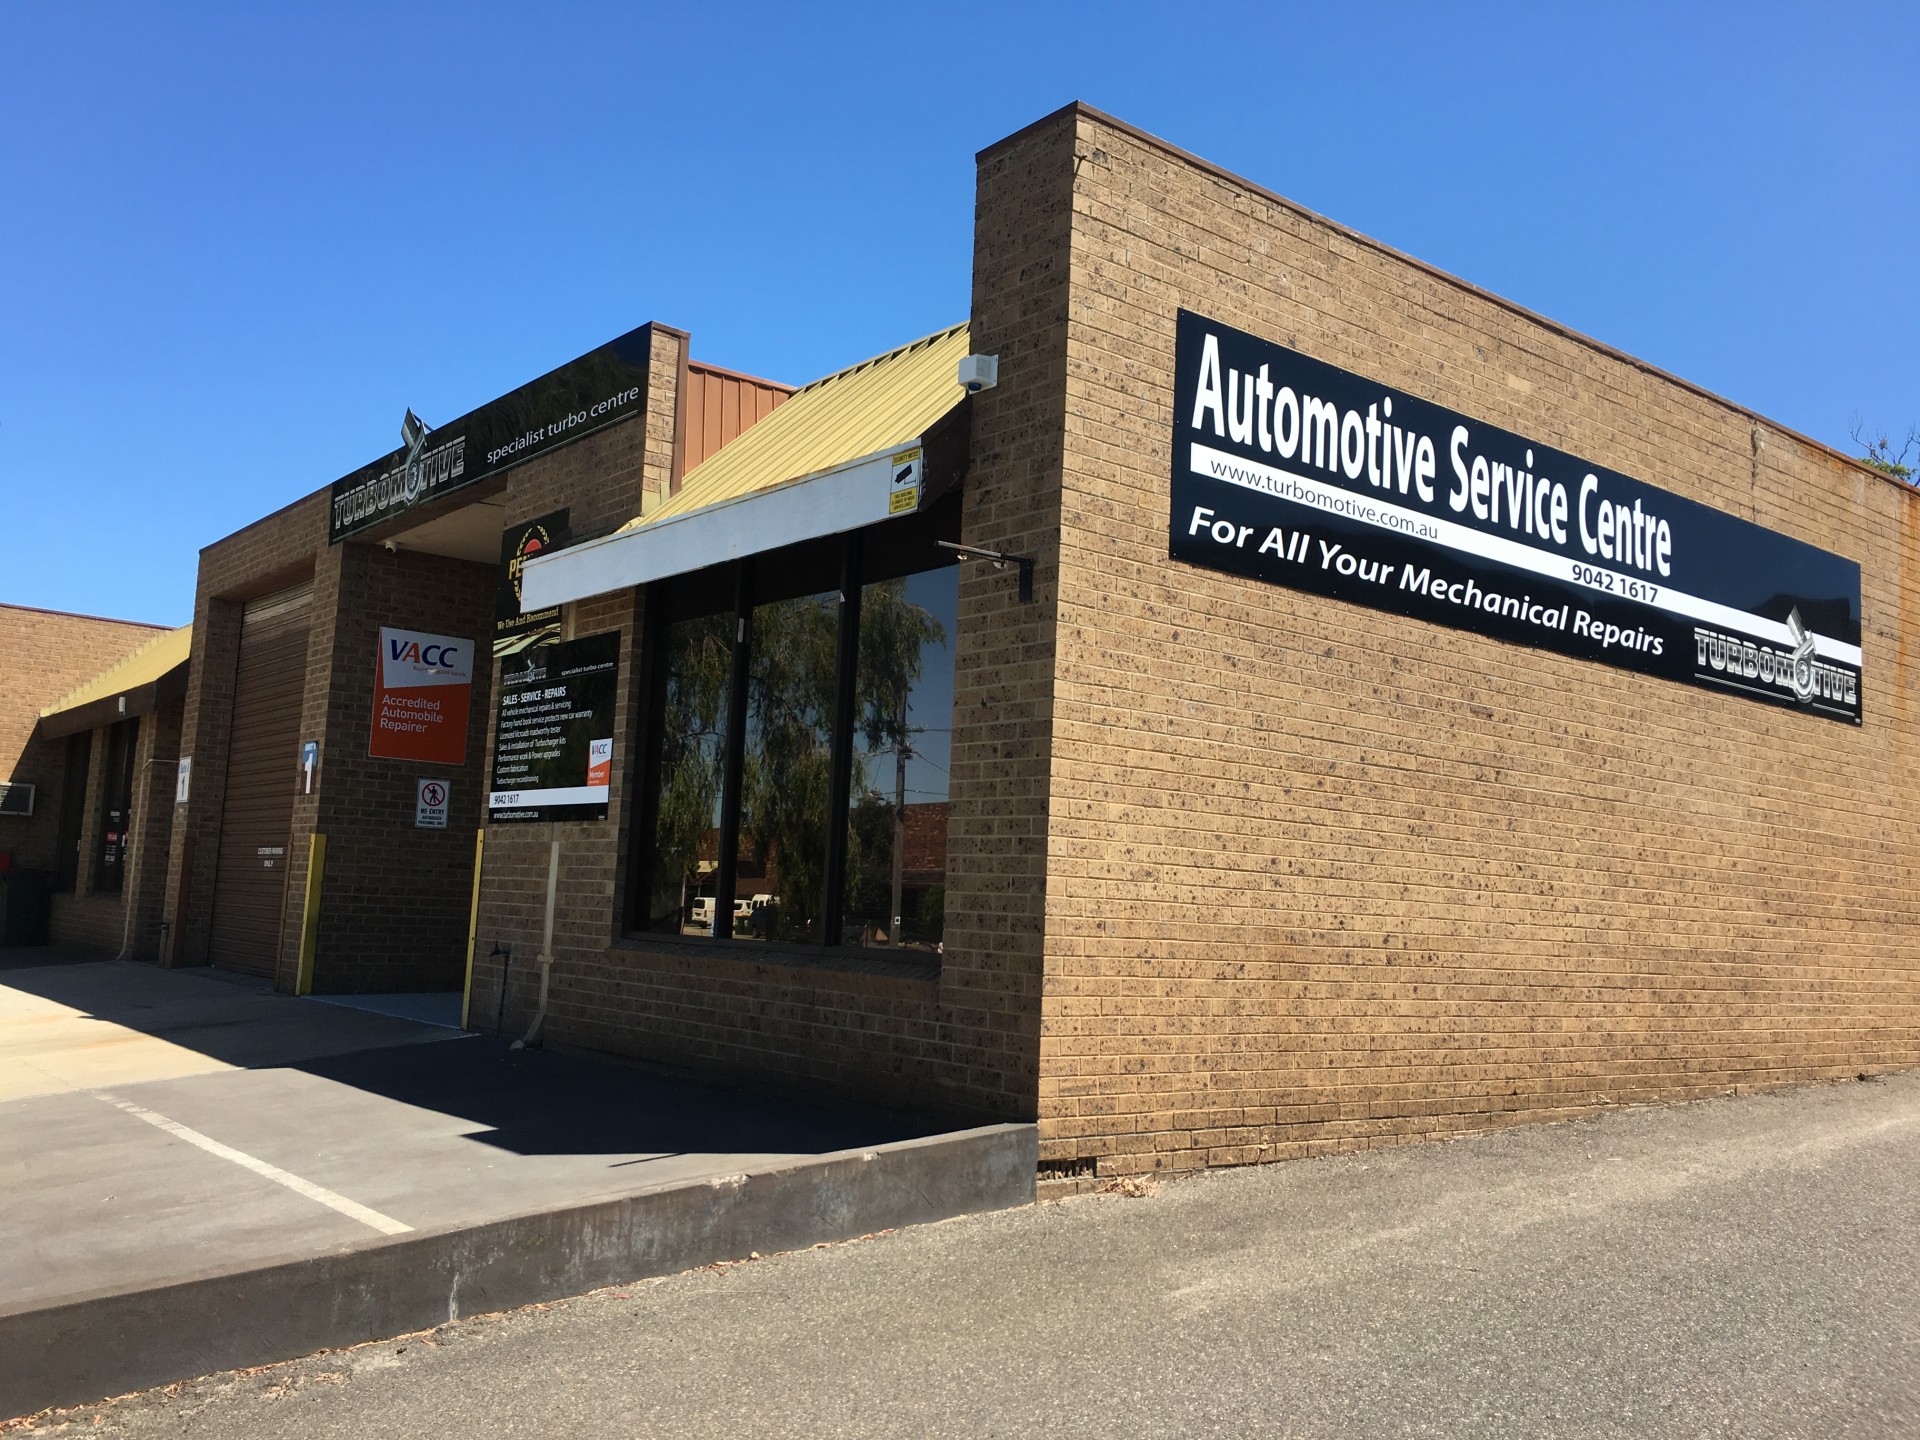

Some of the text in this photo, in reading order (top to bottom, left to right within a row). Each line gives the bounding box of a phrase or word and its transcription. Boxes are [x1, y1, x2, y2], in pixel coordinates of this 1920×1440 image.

[487, 387, 639, 464] specialist turbo centre
[1191, 333, 1672, 577] Automotive Service Centre
[335, 435, 466, 530] TURBOMOTIVE
[1210, 459, 1439, 540] www.turbomotive.com.au
[1188, 506, 1665, 656] For All Your Mechanical Repairs
[1572, 564, 1659, 603] 9042 1617
[497, 607, 559, 630] We Use And Recommend
[390, 638, 458, 668] VACC
[1694, 627, 1857, 705] TURBOMOTIVE
[561, 662, 614, 676] specialist turbo centre
[382, 694, 440, 711] Accredited
[502, 694, 518, 706] SALES
[520, 690, 542, 703] SERVICE
[544, 686, 567, 699] REPAIRS
[380, 718, 428, 733] Repairer
[381, 707, 443, 723] Automobile
[494, 794, 519, 804] 9042 1617
